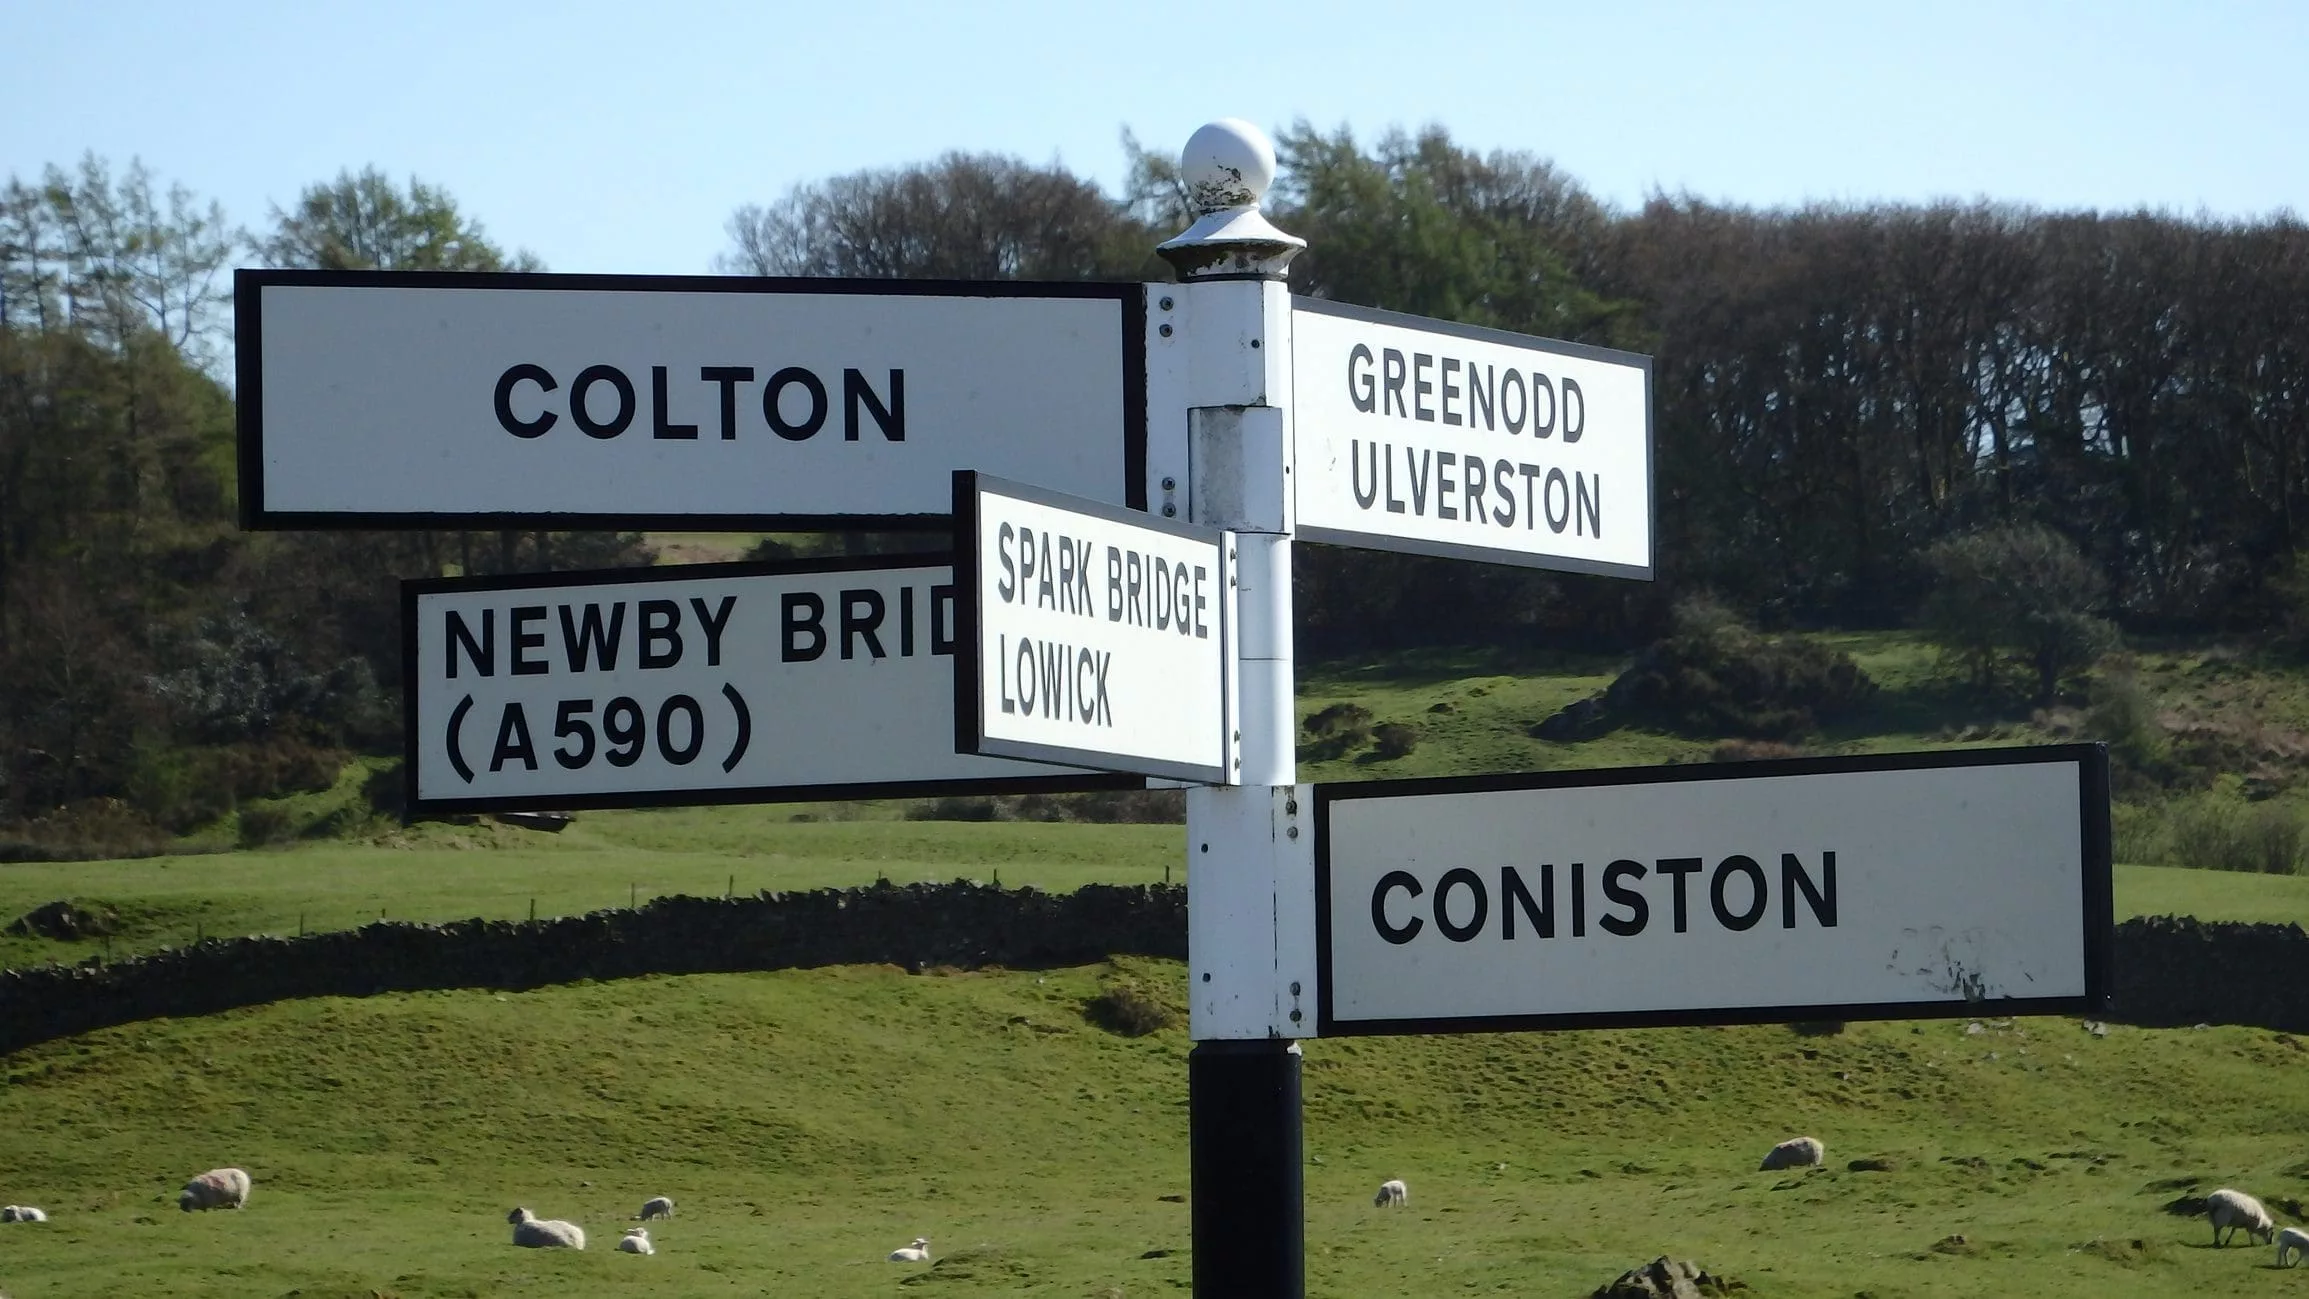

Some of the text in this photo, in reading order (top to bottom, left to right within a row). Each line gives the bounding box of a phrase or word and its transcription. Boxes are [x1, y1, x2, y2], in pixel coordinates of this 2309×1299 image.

[493, 363, 907, 443] COLTON
[1348, 341, 1586, 445] GREENODD
[1351, 438, 1602, 541] ULVERSTON
[998, 520, 1209, 641] SPARK BRIDGE
[444, 588, 736, 680] NEWBY
[1000, 632, 1114, 729] LOWICK
[445, 682, 753, 786] (A590)
[1371, 849, 1839, 946] CONISTON
